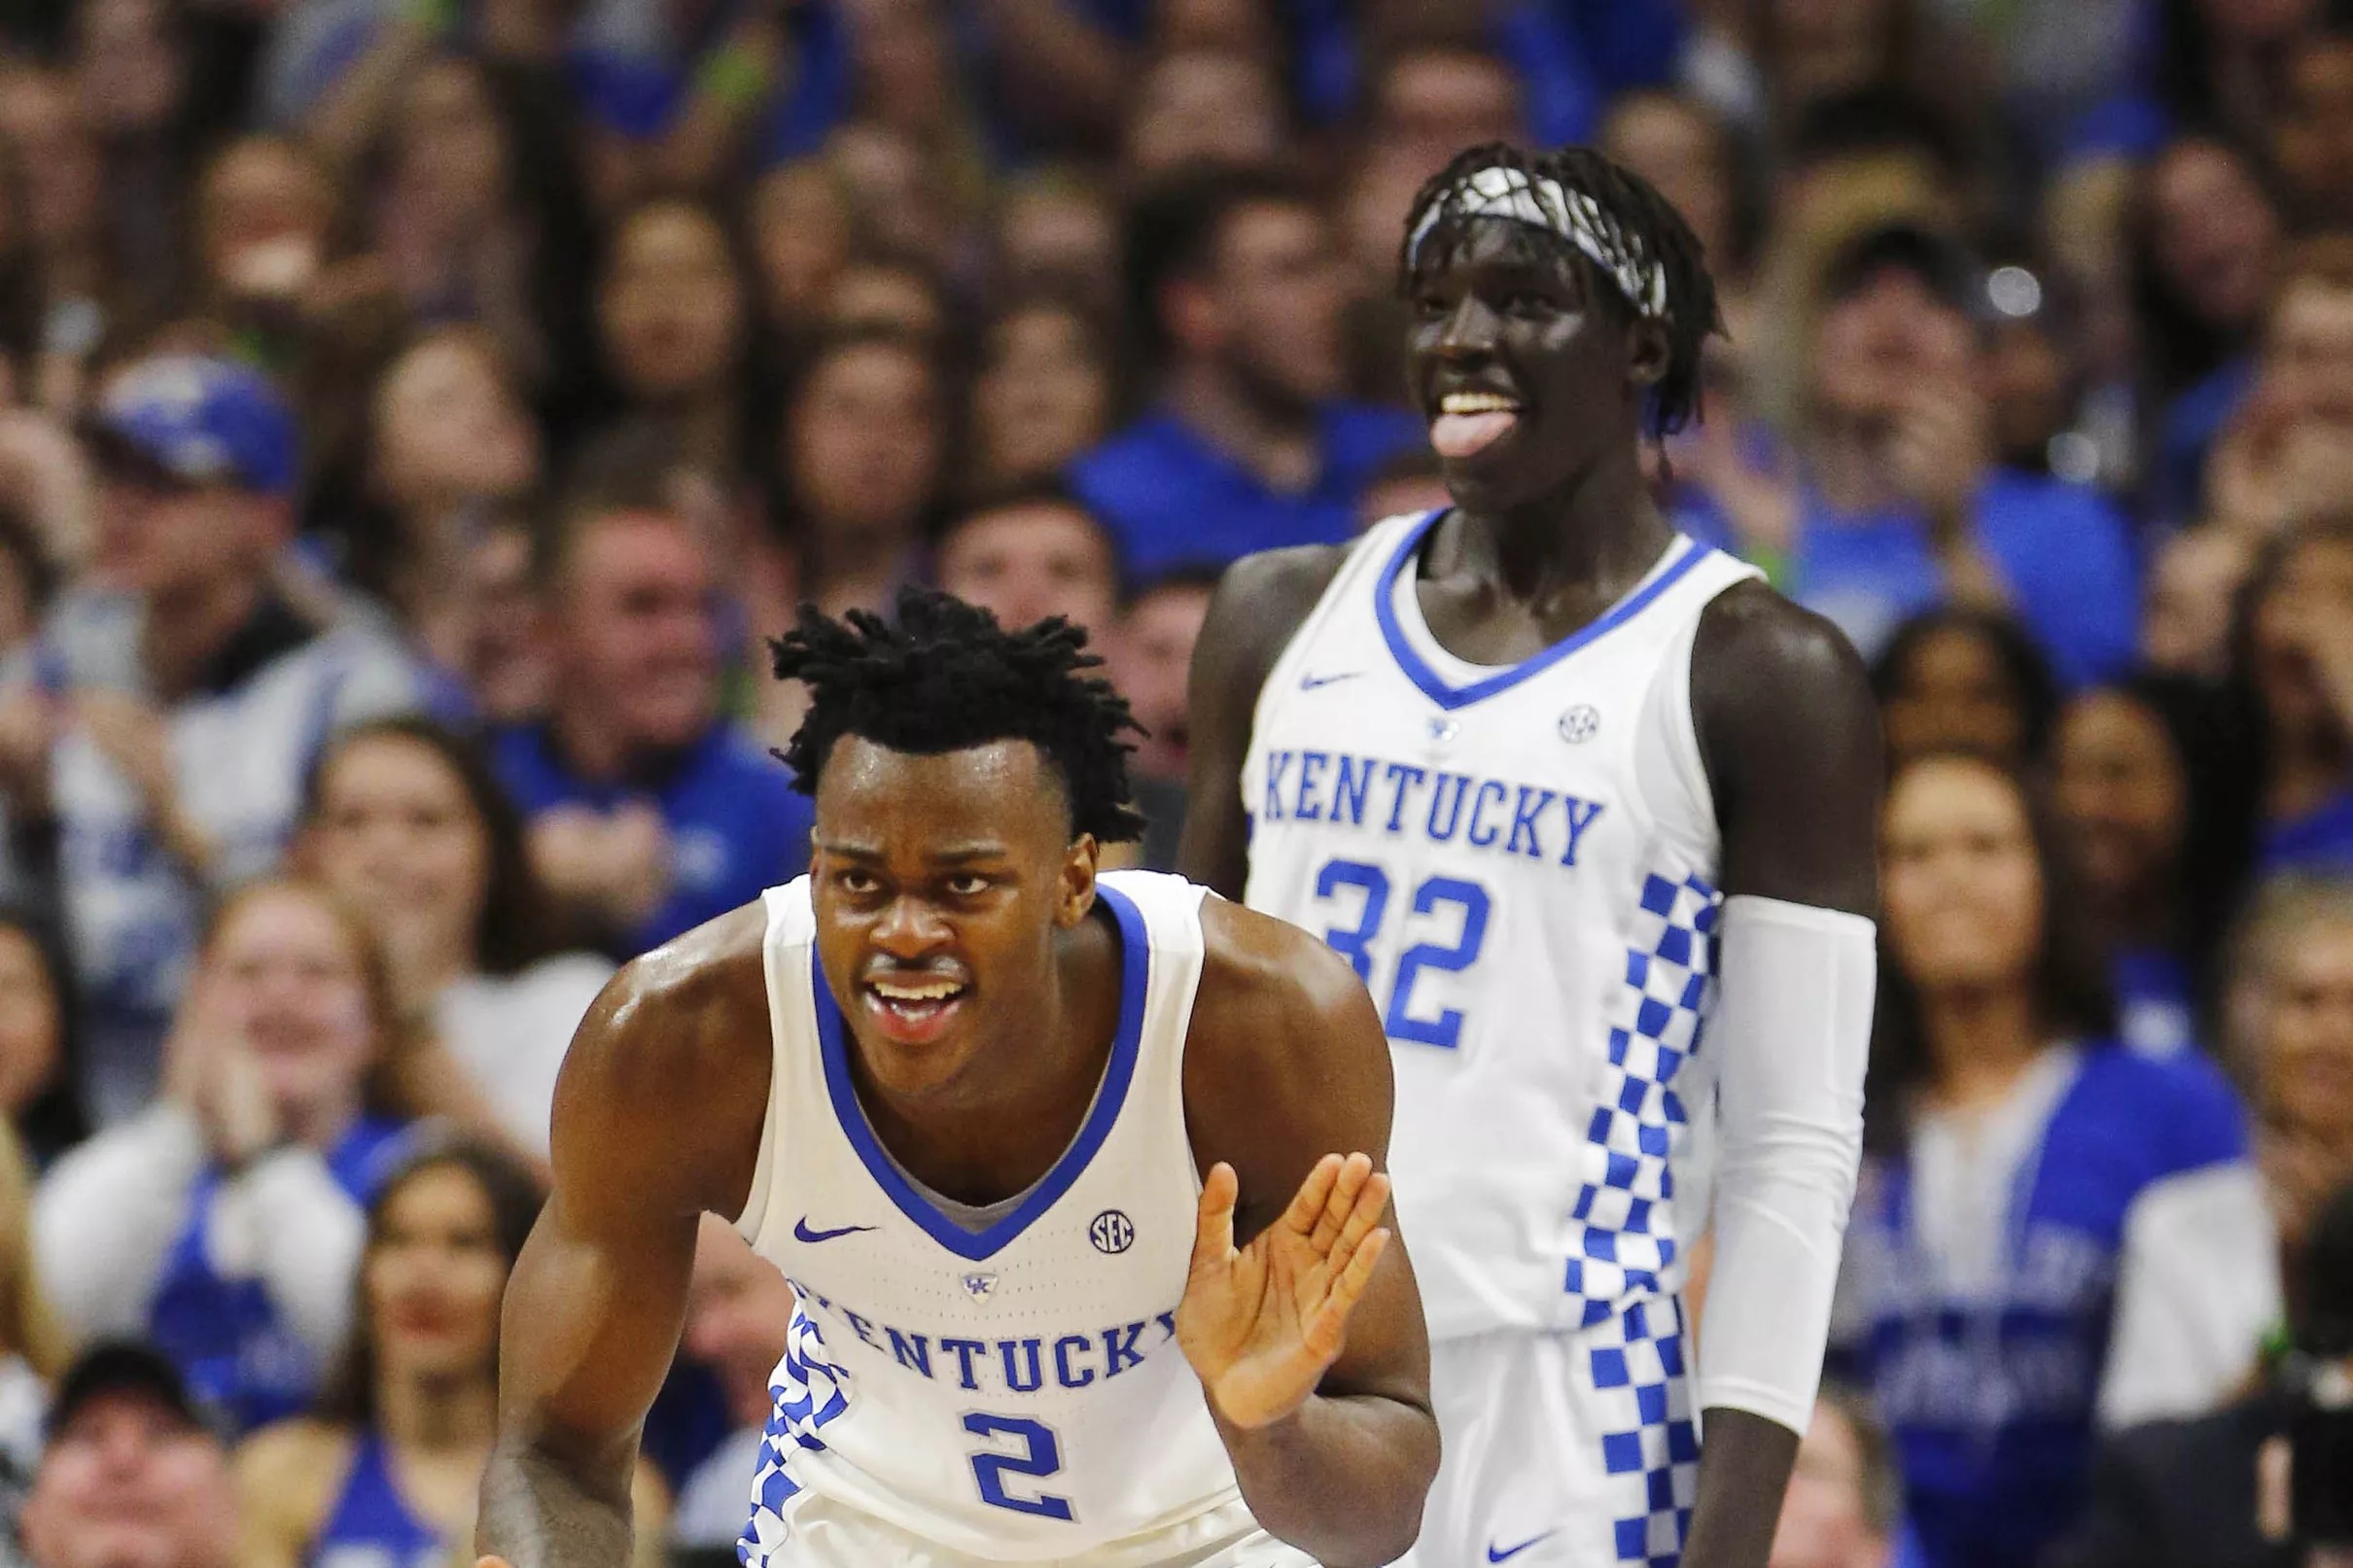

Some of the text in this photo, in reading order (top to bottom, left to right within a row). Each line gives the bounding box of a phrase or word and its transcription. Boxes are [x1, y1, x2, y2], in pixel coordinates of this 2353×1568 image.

[1264, 749, 1604, 867] KENTUCKY
[1317, 858, 1492, 1049] 32
[1090, 1210, 1135, 1254] SEC
[786, 1278, 1176, 1393] ENTUCK
[962, 1410, 1081, 1525] 2
